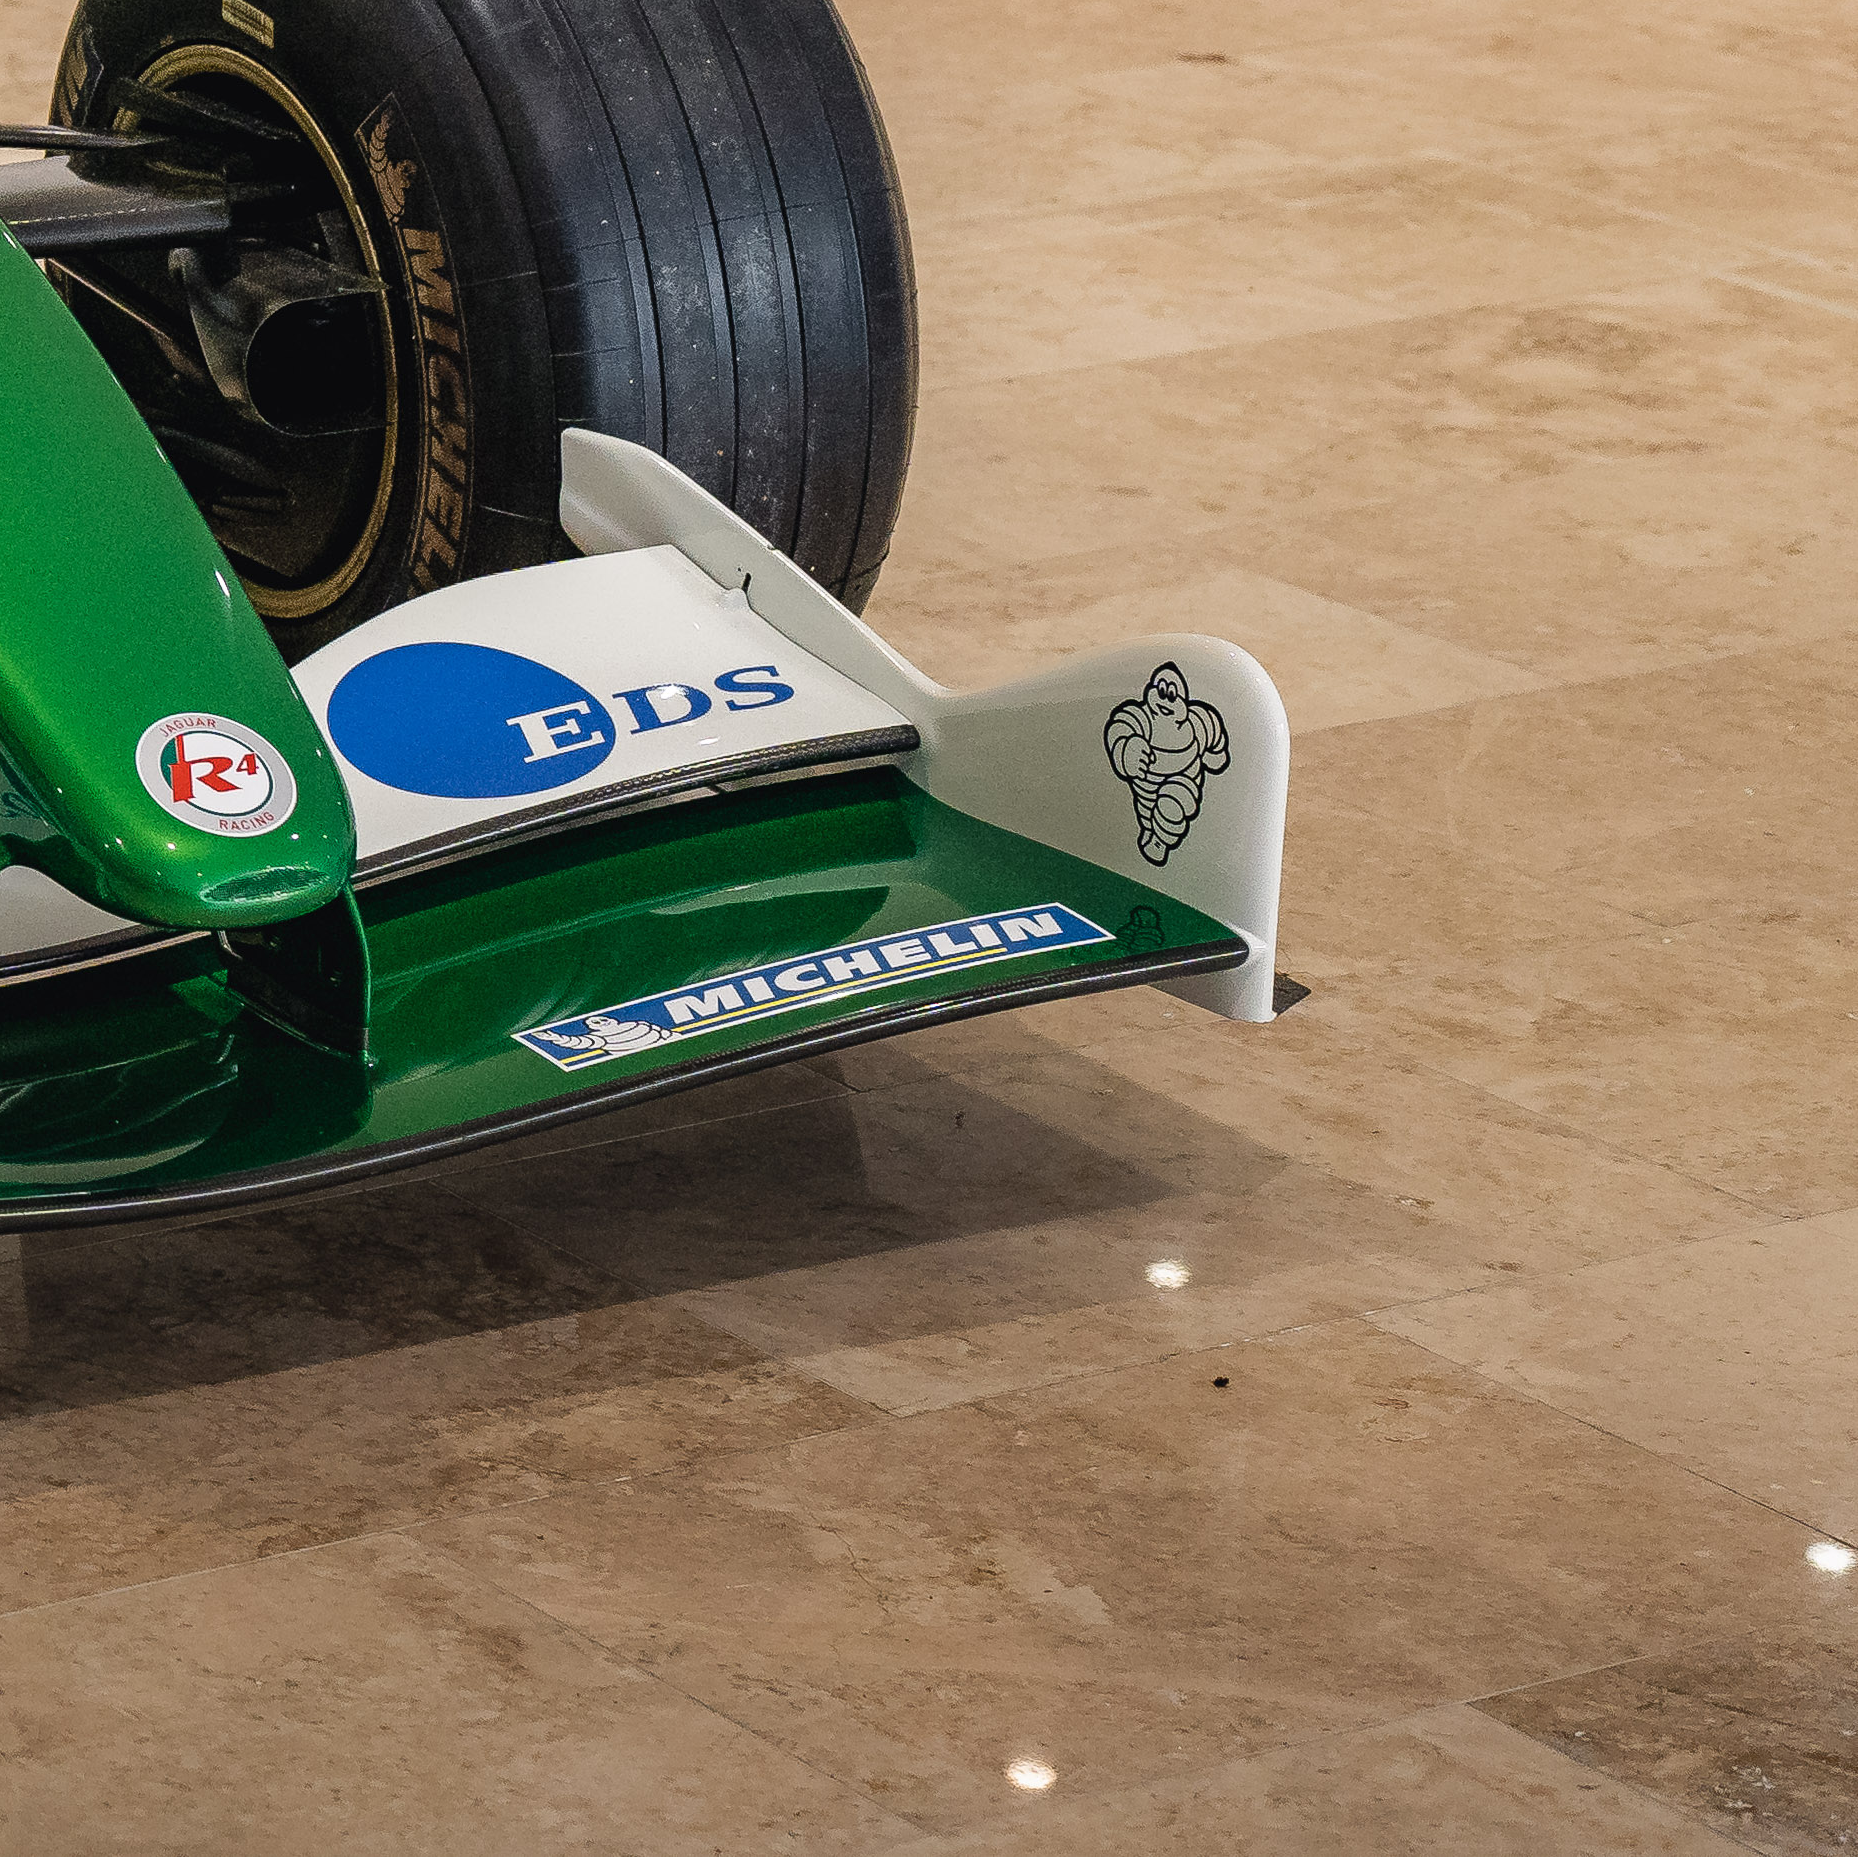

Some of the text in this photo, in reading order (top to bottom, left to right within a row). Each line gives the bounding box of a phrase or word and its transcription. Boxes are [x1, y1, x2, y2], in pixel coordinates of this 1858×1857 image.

[402, 227, 469, 598] MICHELI
[158, 717, 218, 738] JAGUAR
[506, 664, 796, 766] EDS
[218, 811, 276, 832] RACING
[662, 913, 1065, 1026] MICHELIN
